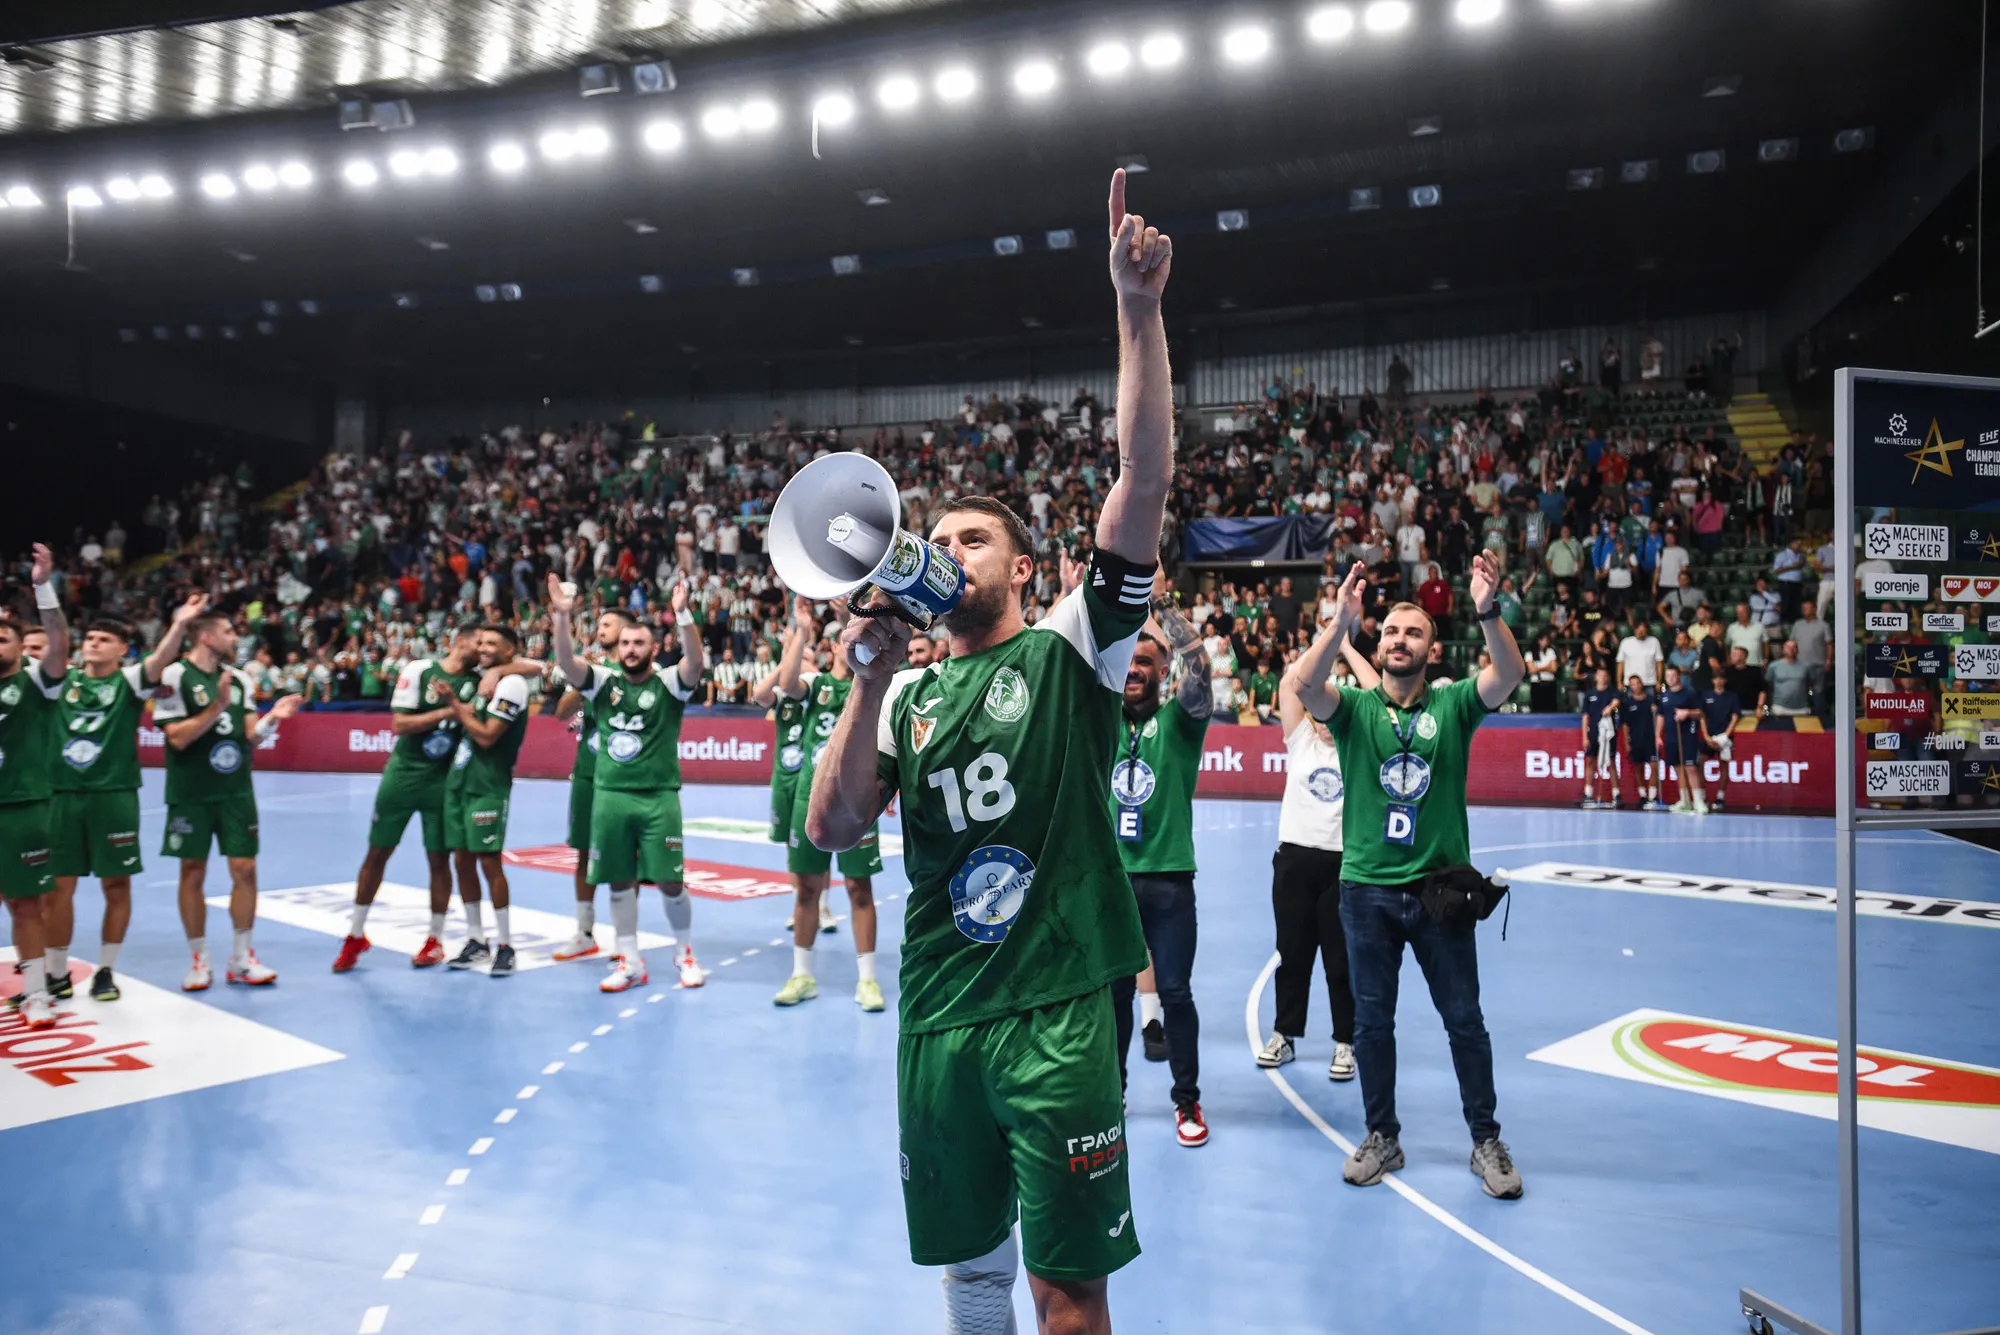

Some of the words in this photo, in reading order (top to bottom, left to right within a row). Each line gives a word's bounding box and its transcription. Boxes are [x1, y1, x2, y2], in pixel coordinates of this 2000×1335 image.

[1874, 436, 1922, 447] MACHINESEEKER
[1980, 430, 1999, 443] EHF
[1975, 463, 2000, 476] LEAGU
[1892, 527, 1945, 542] MACHINE
[1897, 543, 1941, 558] SEEKER
[1874, 579, 1920, 597] gorenje
[1946, 580, 1962, 589] MOL
[1976, 581, 1991, 590] MOL
[1871, 616, 1902, 627] SELECT
[1927, 615, 1954, 626] Gerflor
[1870, 698, 1925, 709] MODULAR
[1962, 697, 2000, 706] Raiffeisen
[1962, 706, 1981, 715] Bank
[608, 711, 645, 731] 44
[677, 736, 768, 761] odular
[1889, 764, 1948, 777] MASCHINEN
[1899, 779, 1940, 792] SUCHER
[927, 752, 1017, 833] 18
[1120, 811, 1138, 837] E
[1387, 811, 1412, 839] D
[953, 894, 984, 913] EURO
[1663, 1032, 1936, 1087] MOL
